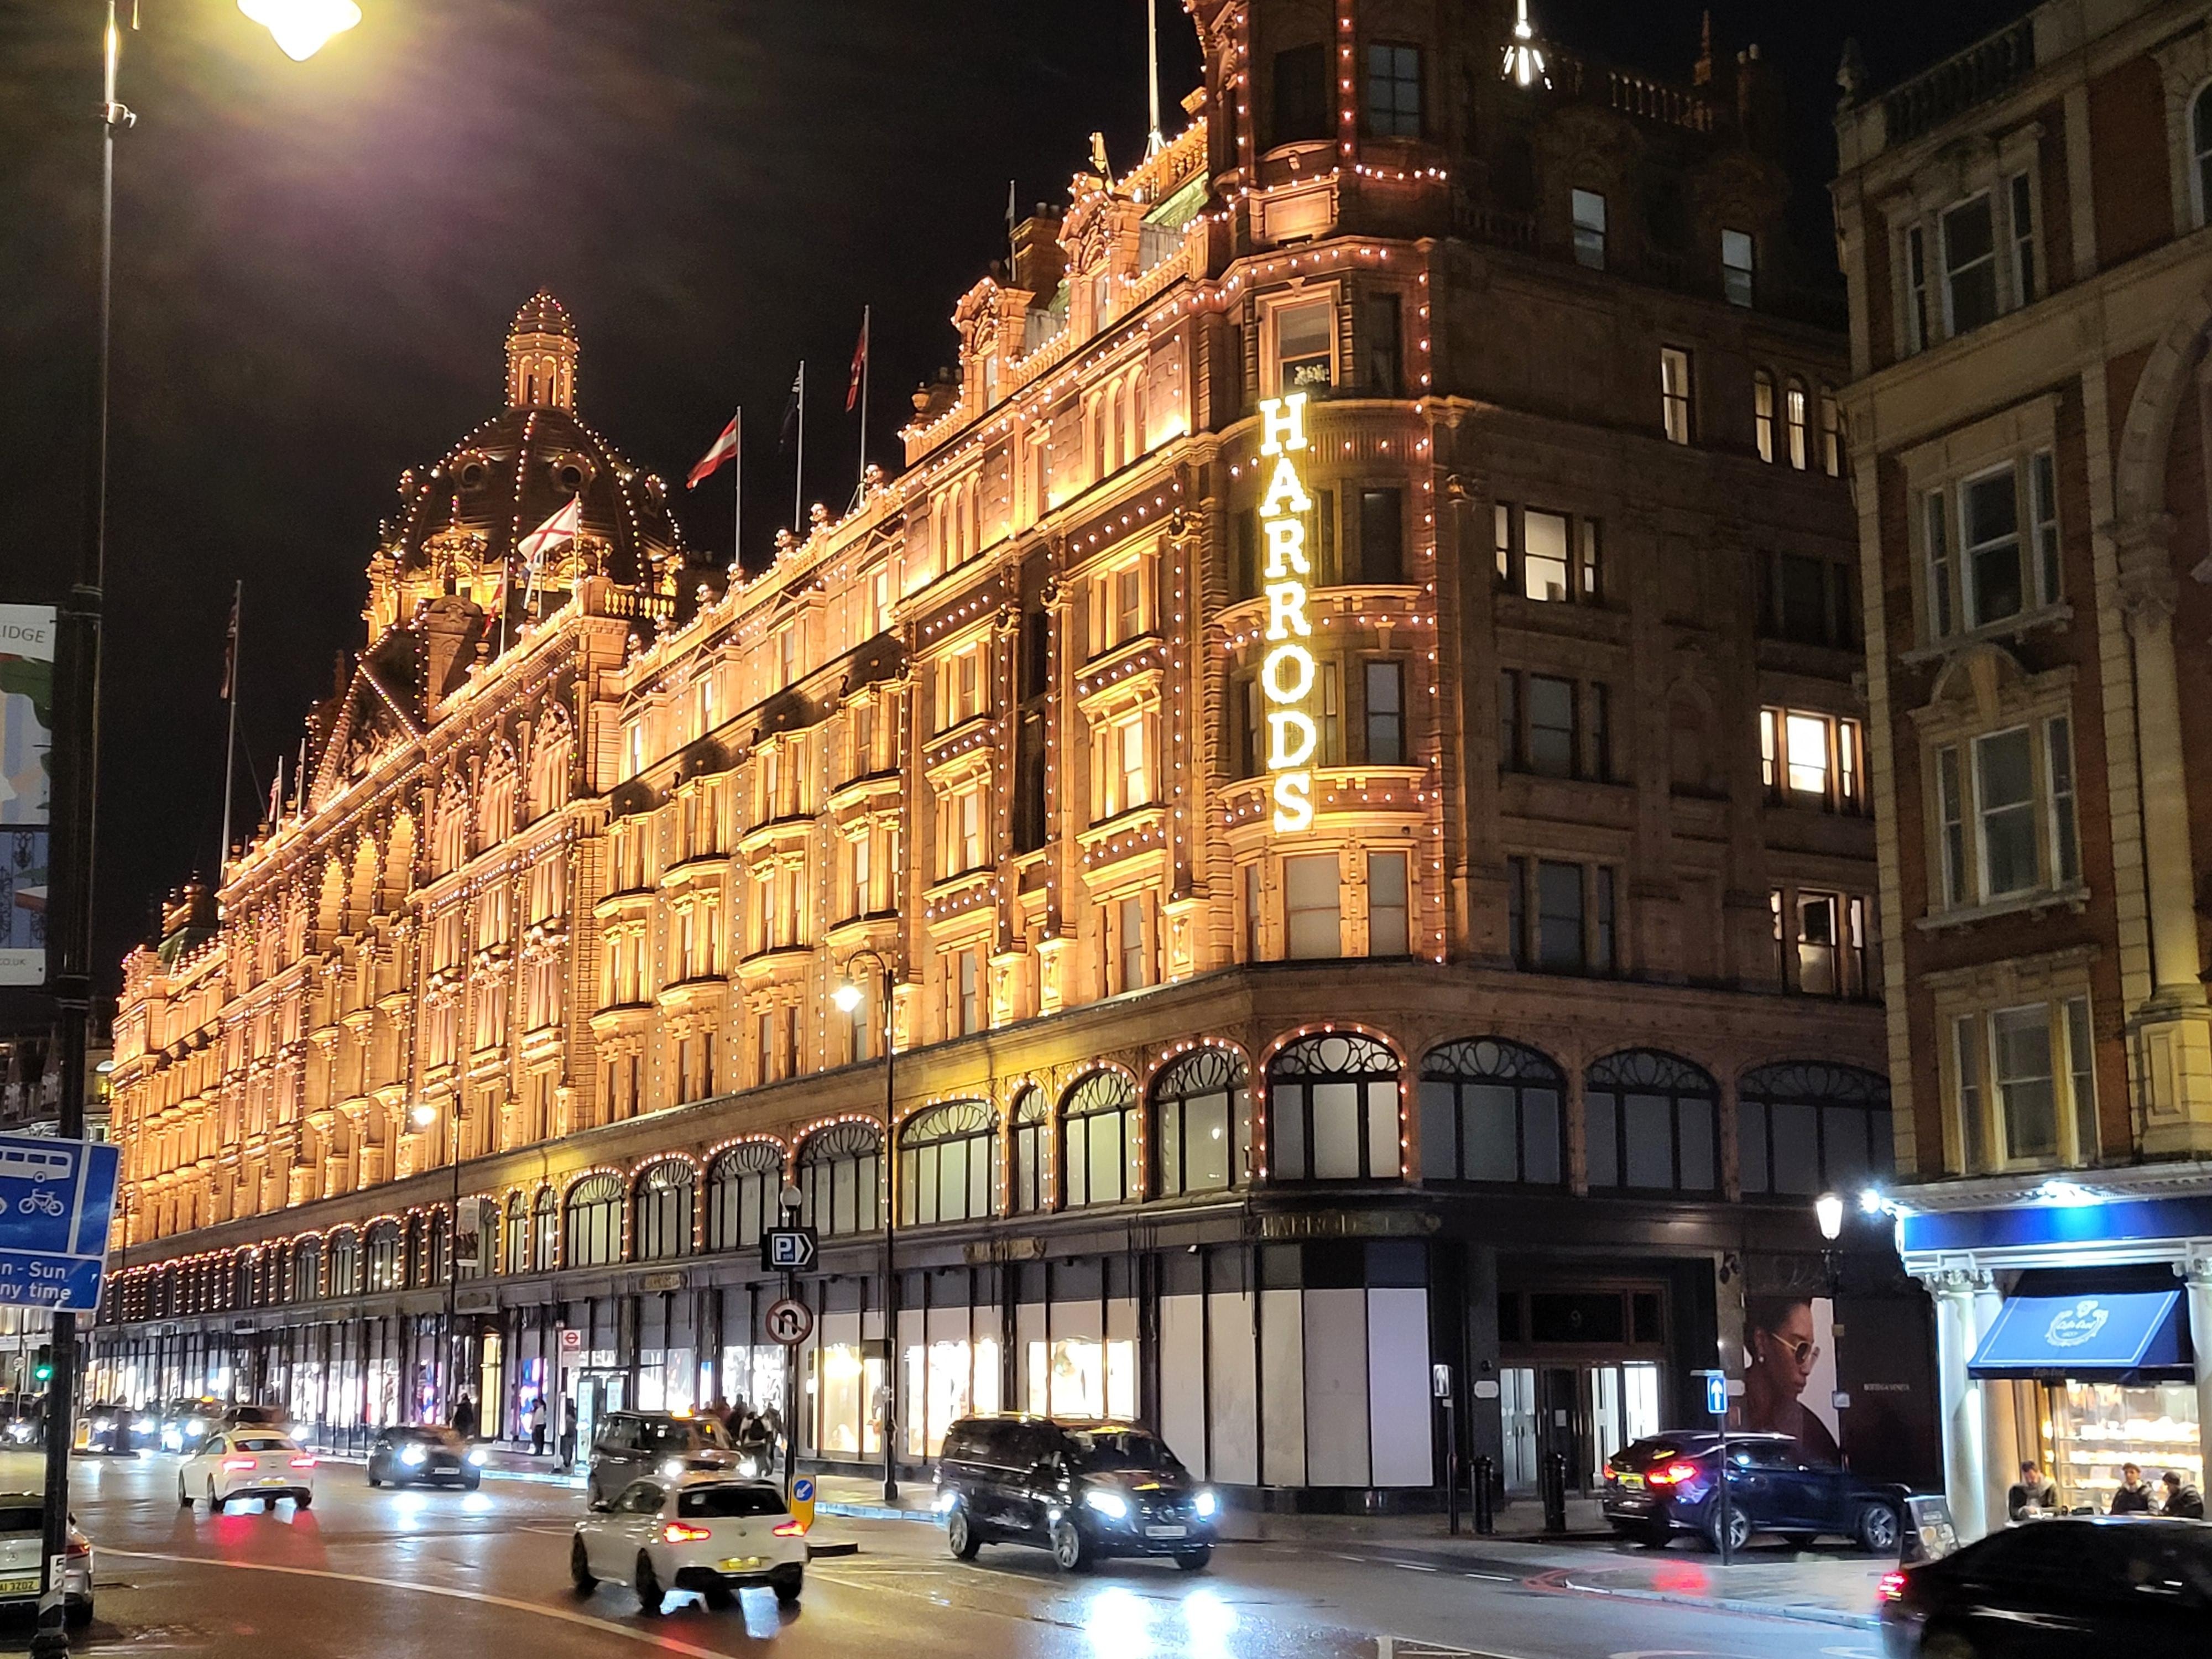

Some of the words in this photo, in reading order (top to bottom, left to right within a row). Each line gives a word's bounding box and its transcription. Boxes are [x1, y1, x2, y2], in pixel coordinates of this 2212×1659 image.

[1259, 392, 1317, 833] HARRODS
[0, 625, 45, 643] IDGE
[776, 1237, 792, 1260] P
[28, 1261, 66, 1280] Sun
[28, 1281, 72, 1301] time
